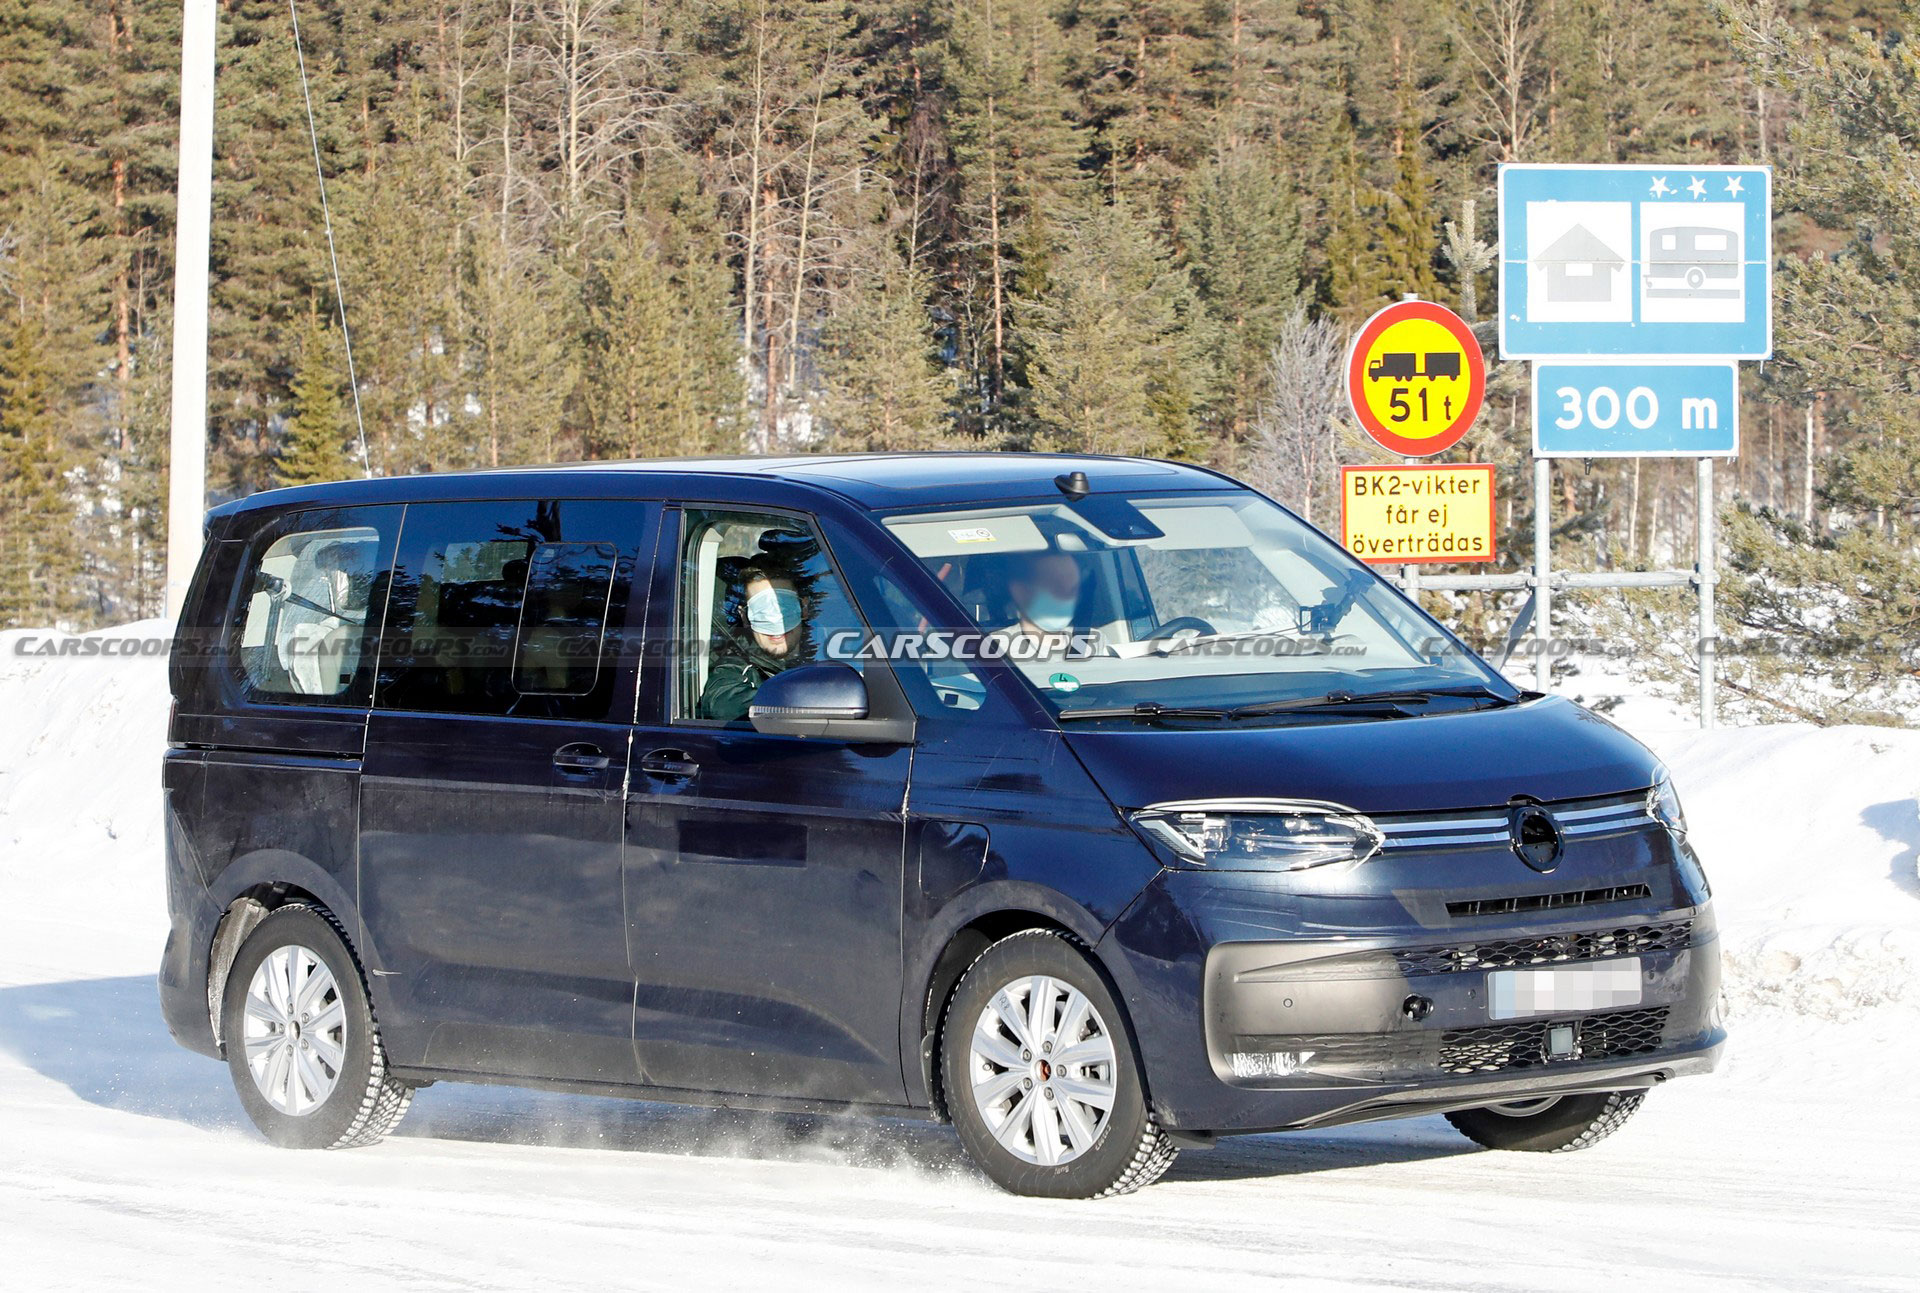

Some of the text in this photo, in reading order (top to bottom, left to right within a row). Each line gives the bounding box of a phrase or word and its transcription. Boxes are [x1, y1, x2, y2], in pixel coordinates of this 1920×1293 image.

[1390, 388, 1452, 422] 51 t
[1554, 386, 1718, 430] 300 m
[1354, 475, 1480, 496] BK2-vikter
[1386, 504, 1447, 528] får ej
[1353, 532, 1483, 554] överträdas
